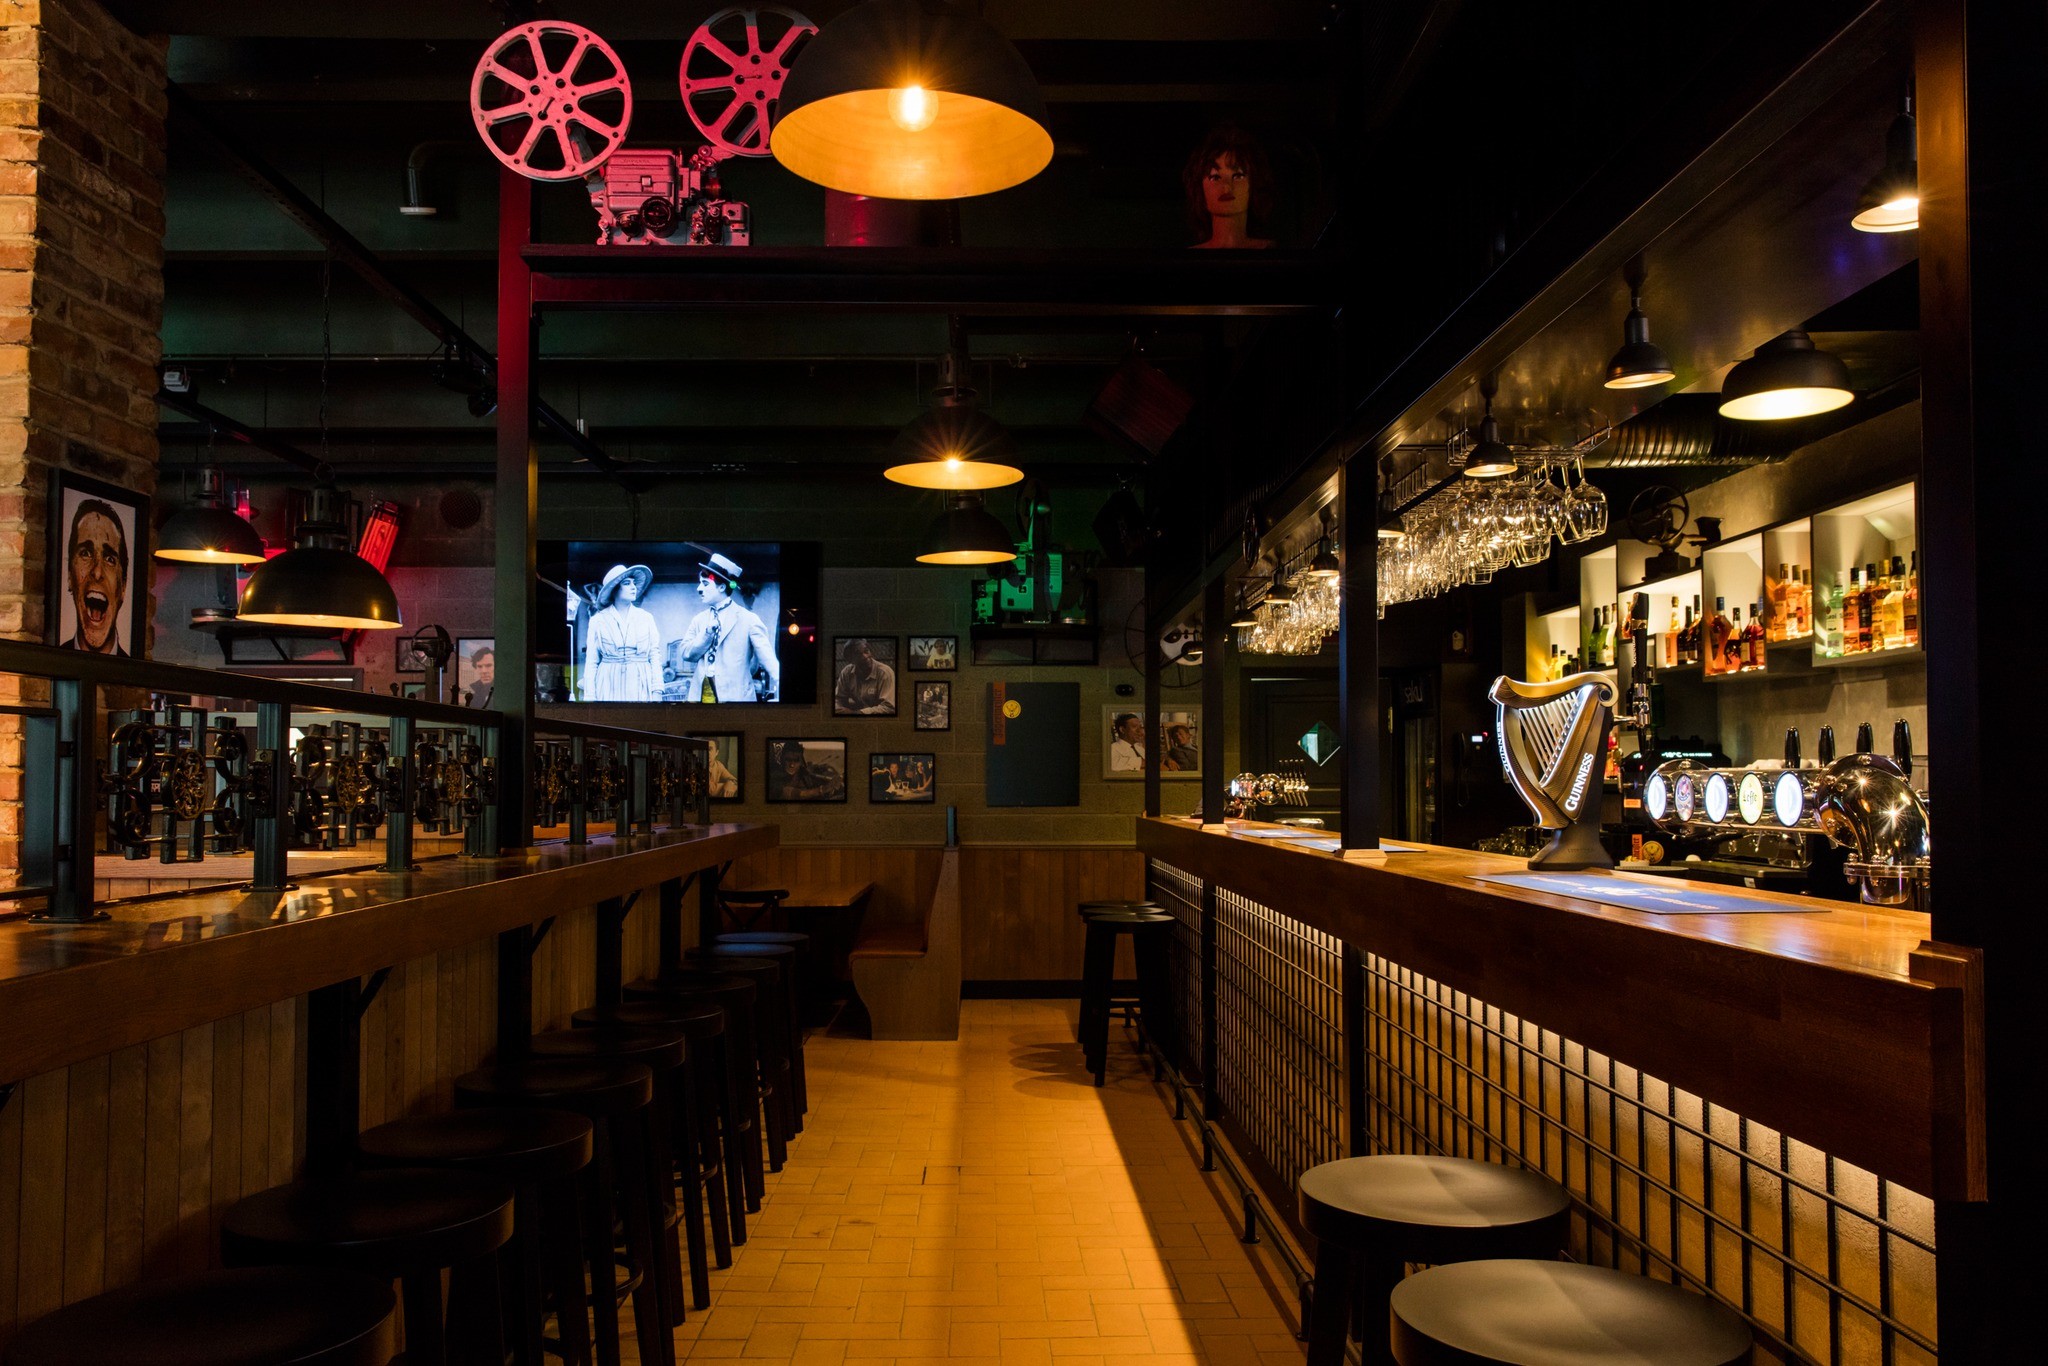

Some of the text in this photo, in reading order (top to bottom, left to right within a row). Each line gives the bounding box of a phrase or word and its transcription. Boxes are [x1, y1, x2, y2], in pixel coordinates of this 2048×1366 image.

[1497, 721, 1510, 773] GUINNESS
[1564, 753, 1595, 812] GUINNESS
[1742, 790, 1757, 805] Leffe
